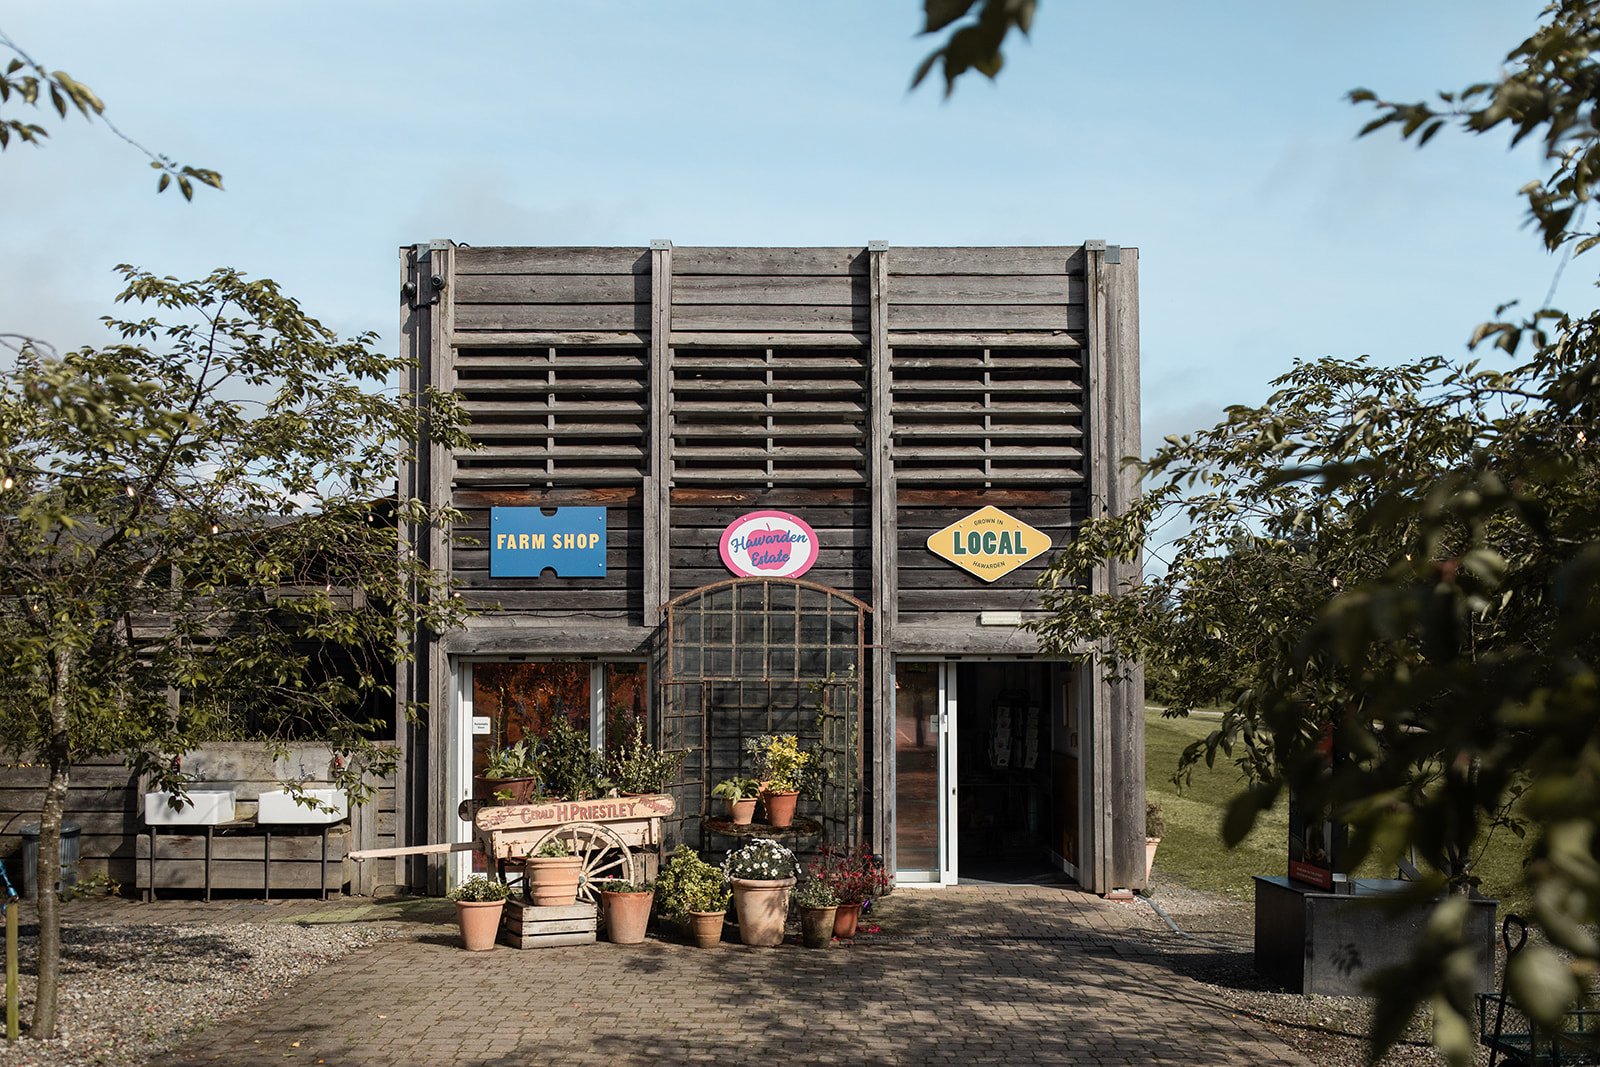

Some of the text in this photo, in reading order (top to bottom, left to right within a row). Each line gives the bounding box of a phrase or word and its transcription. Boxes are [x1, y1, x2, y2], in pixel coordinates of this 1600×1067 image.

[973, 518, 996, 526] GROWN
[497, 533, 600, 549] FARM SHOP
[730, 529, 808, 553] Hawarden
[953, 531, 1027, 555] LOCAL
[751, 549, 791, 567] Estate
[972, 561, 1006, 569] HAWARDEN
